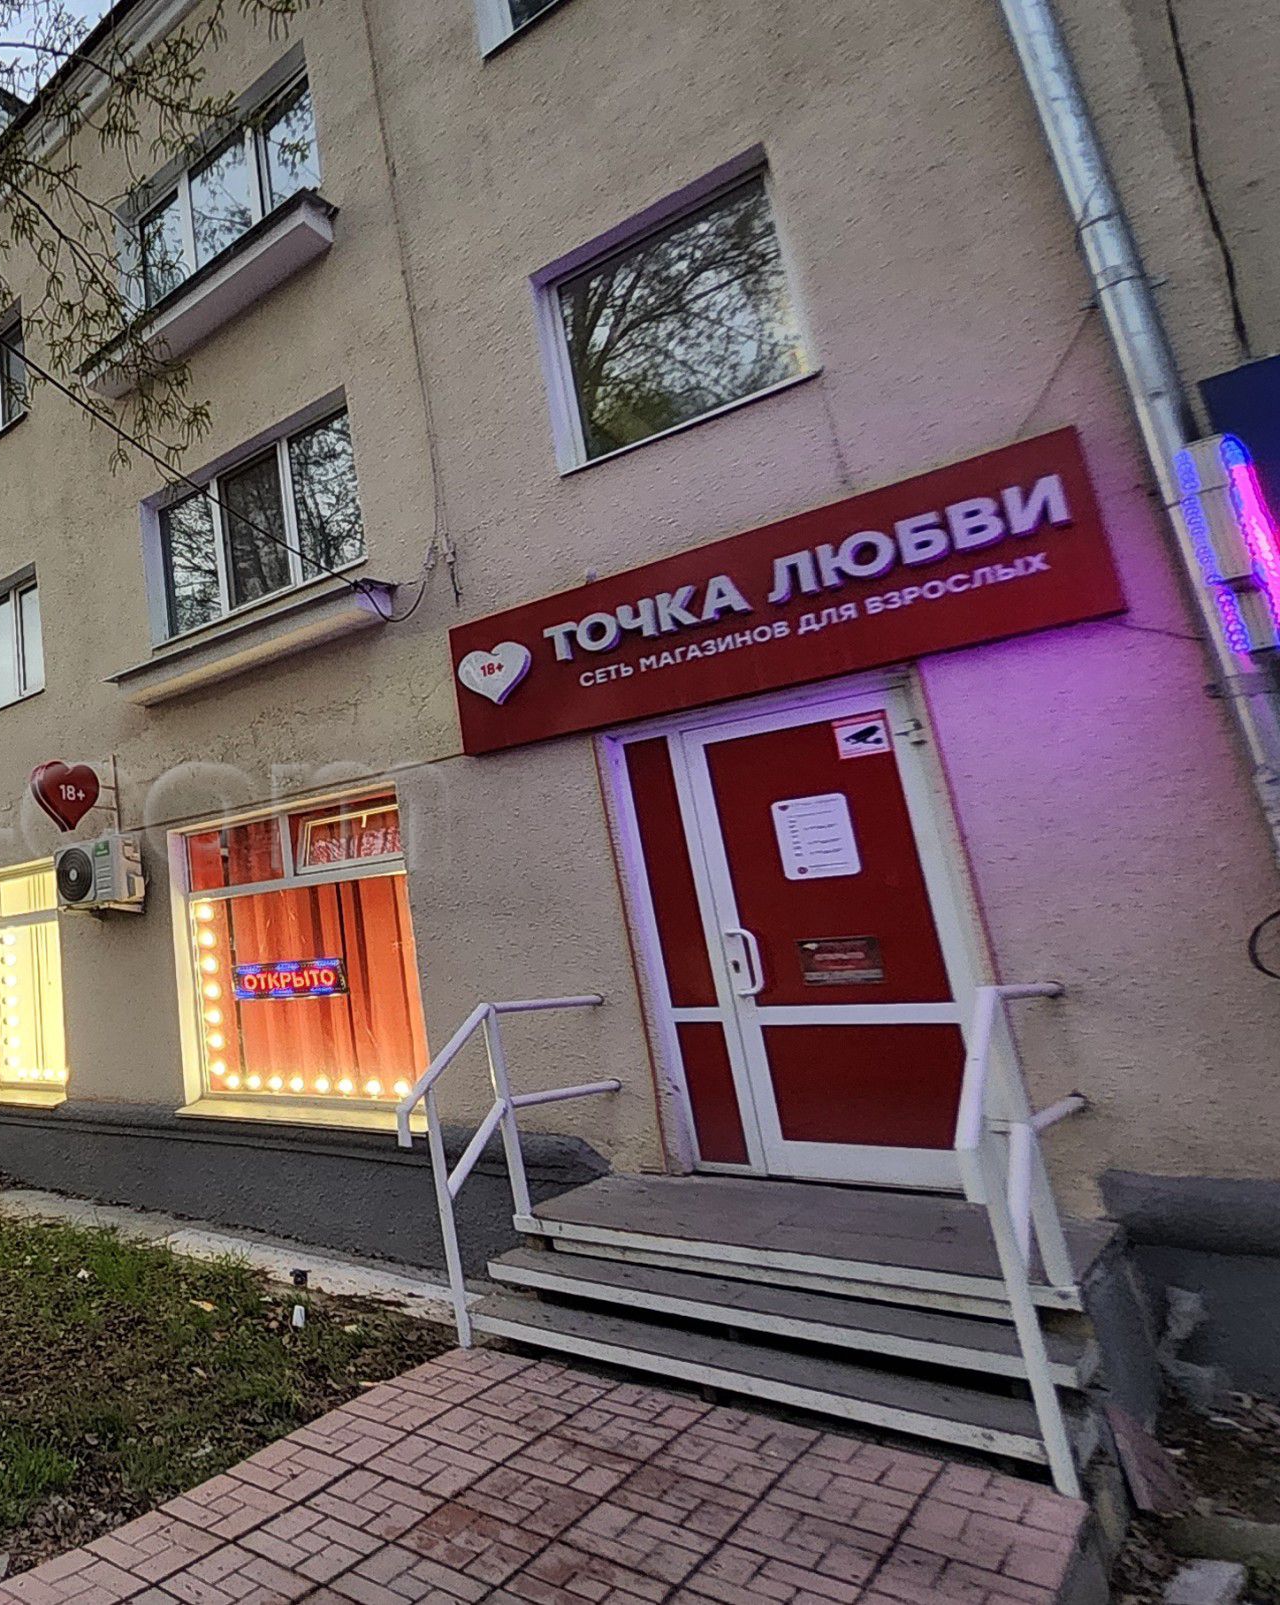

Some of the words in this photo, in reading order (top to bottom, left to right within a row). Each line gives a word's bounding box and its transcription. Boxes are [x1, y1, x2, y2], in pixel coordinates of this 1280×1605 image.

[543, 574, 754, 661] ТОЧКА
[768, 473, 1073, 606] ЛЮБВИ
[578, 661, 634, 688] СЕТЬ
[639, 621, 791, 673] МАГАЗИНОВ
[796, 603, 859, 636] ДЛЯ
[865, 550, 1051, 615] ВЗРОСЛЫХ
[480, 660, 504, 678] 18+
[58, 784, 86, 801] 18+
[243, 969, 335, 991] ОТКРЫТО
